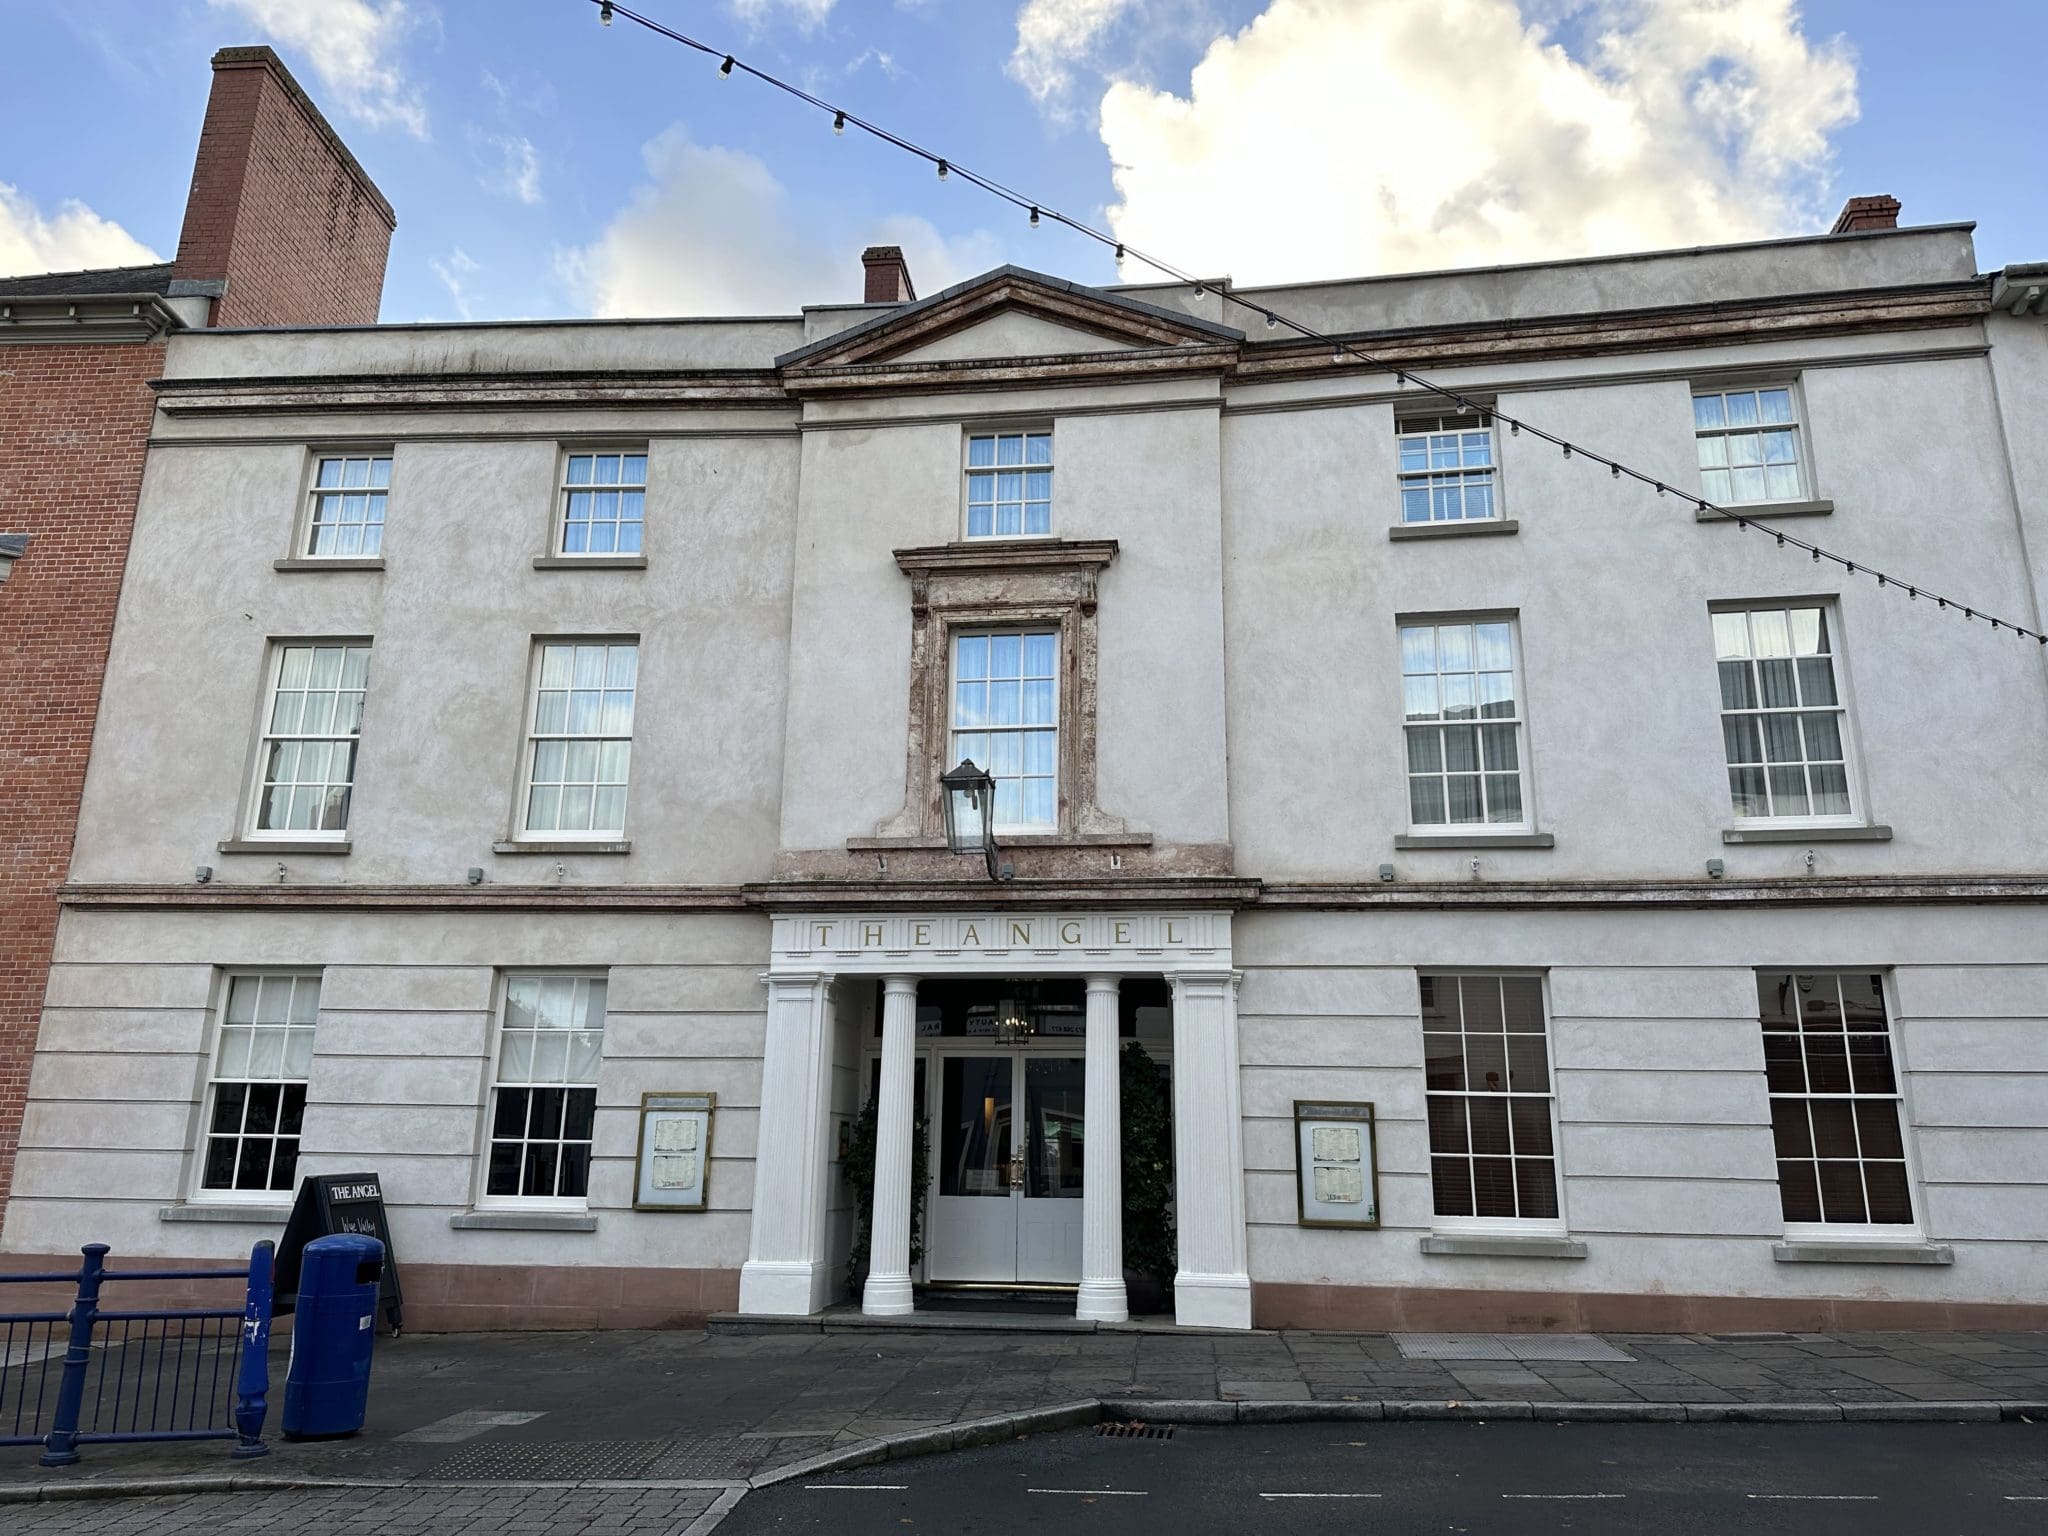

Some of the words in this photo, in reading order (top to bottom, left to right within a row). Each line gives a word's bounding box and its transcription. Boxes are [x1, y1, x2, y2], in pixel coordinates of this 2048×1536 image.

[815, 924, 932, 947] THE
[961, 921, 1184, 946] ANGEL
[331, 1185, 352, 1200] THE
[352, 1184, 381, 1198] ANGEL
